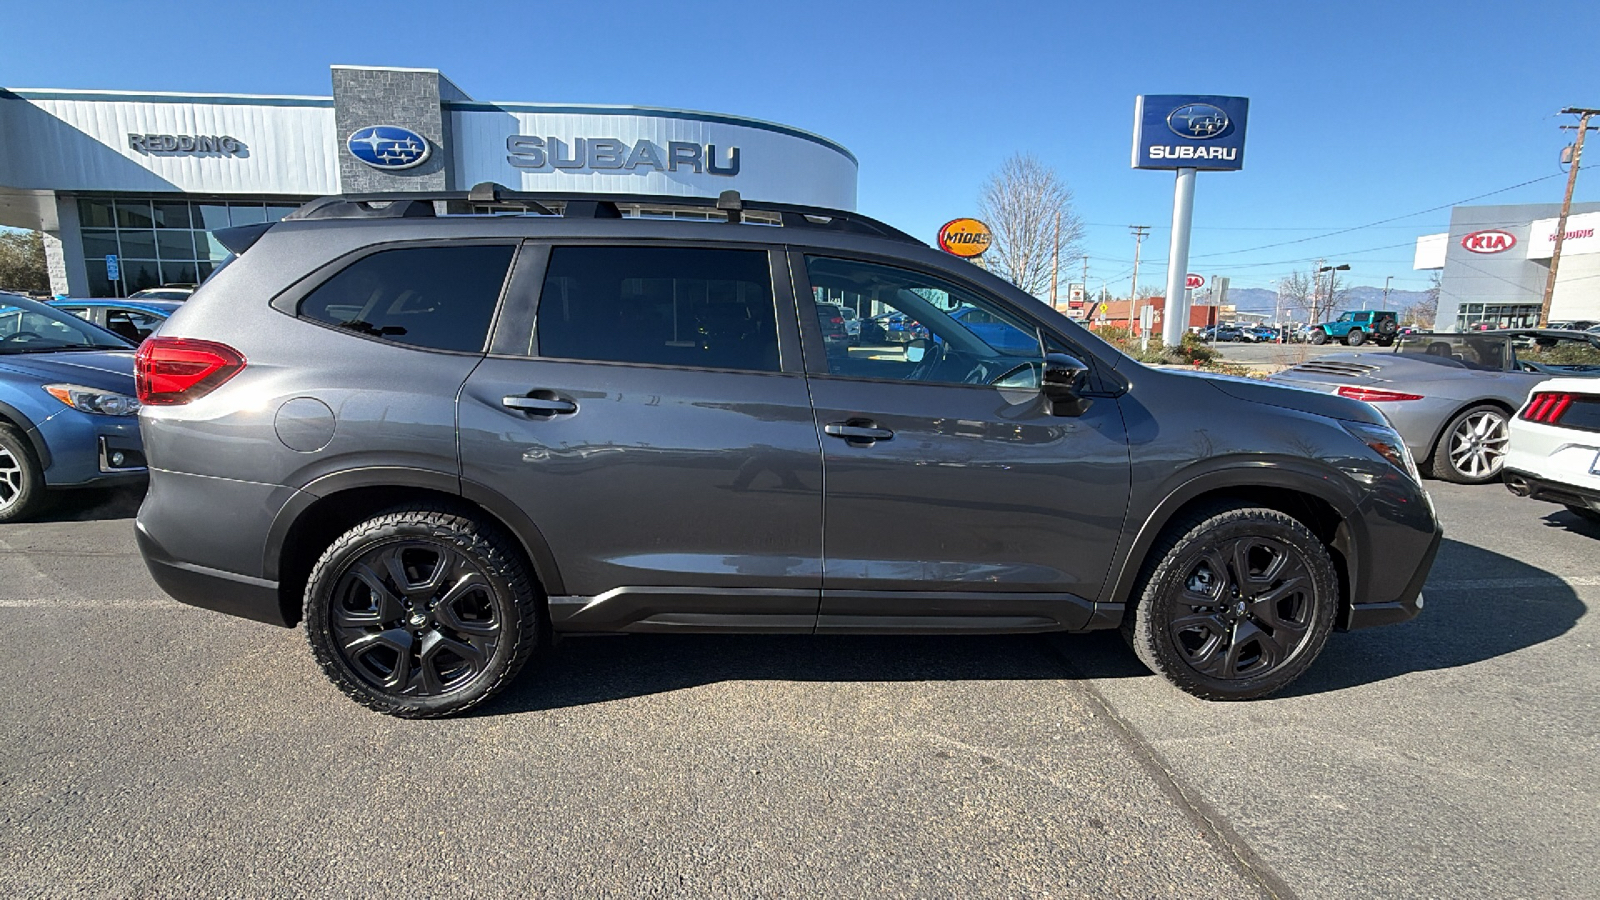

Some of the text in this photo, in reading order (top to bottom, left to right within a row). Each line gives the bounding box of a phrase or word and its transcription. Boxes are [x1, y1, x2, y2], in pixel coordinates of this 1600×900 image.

[127, 133, 239, 153] REDDING
[507, 135, 741, 177] SUBARU
[1149, 145, 1237, 160] SUBARU
[1471, 235, 1507, 249] KIA
